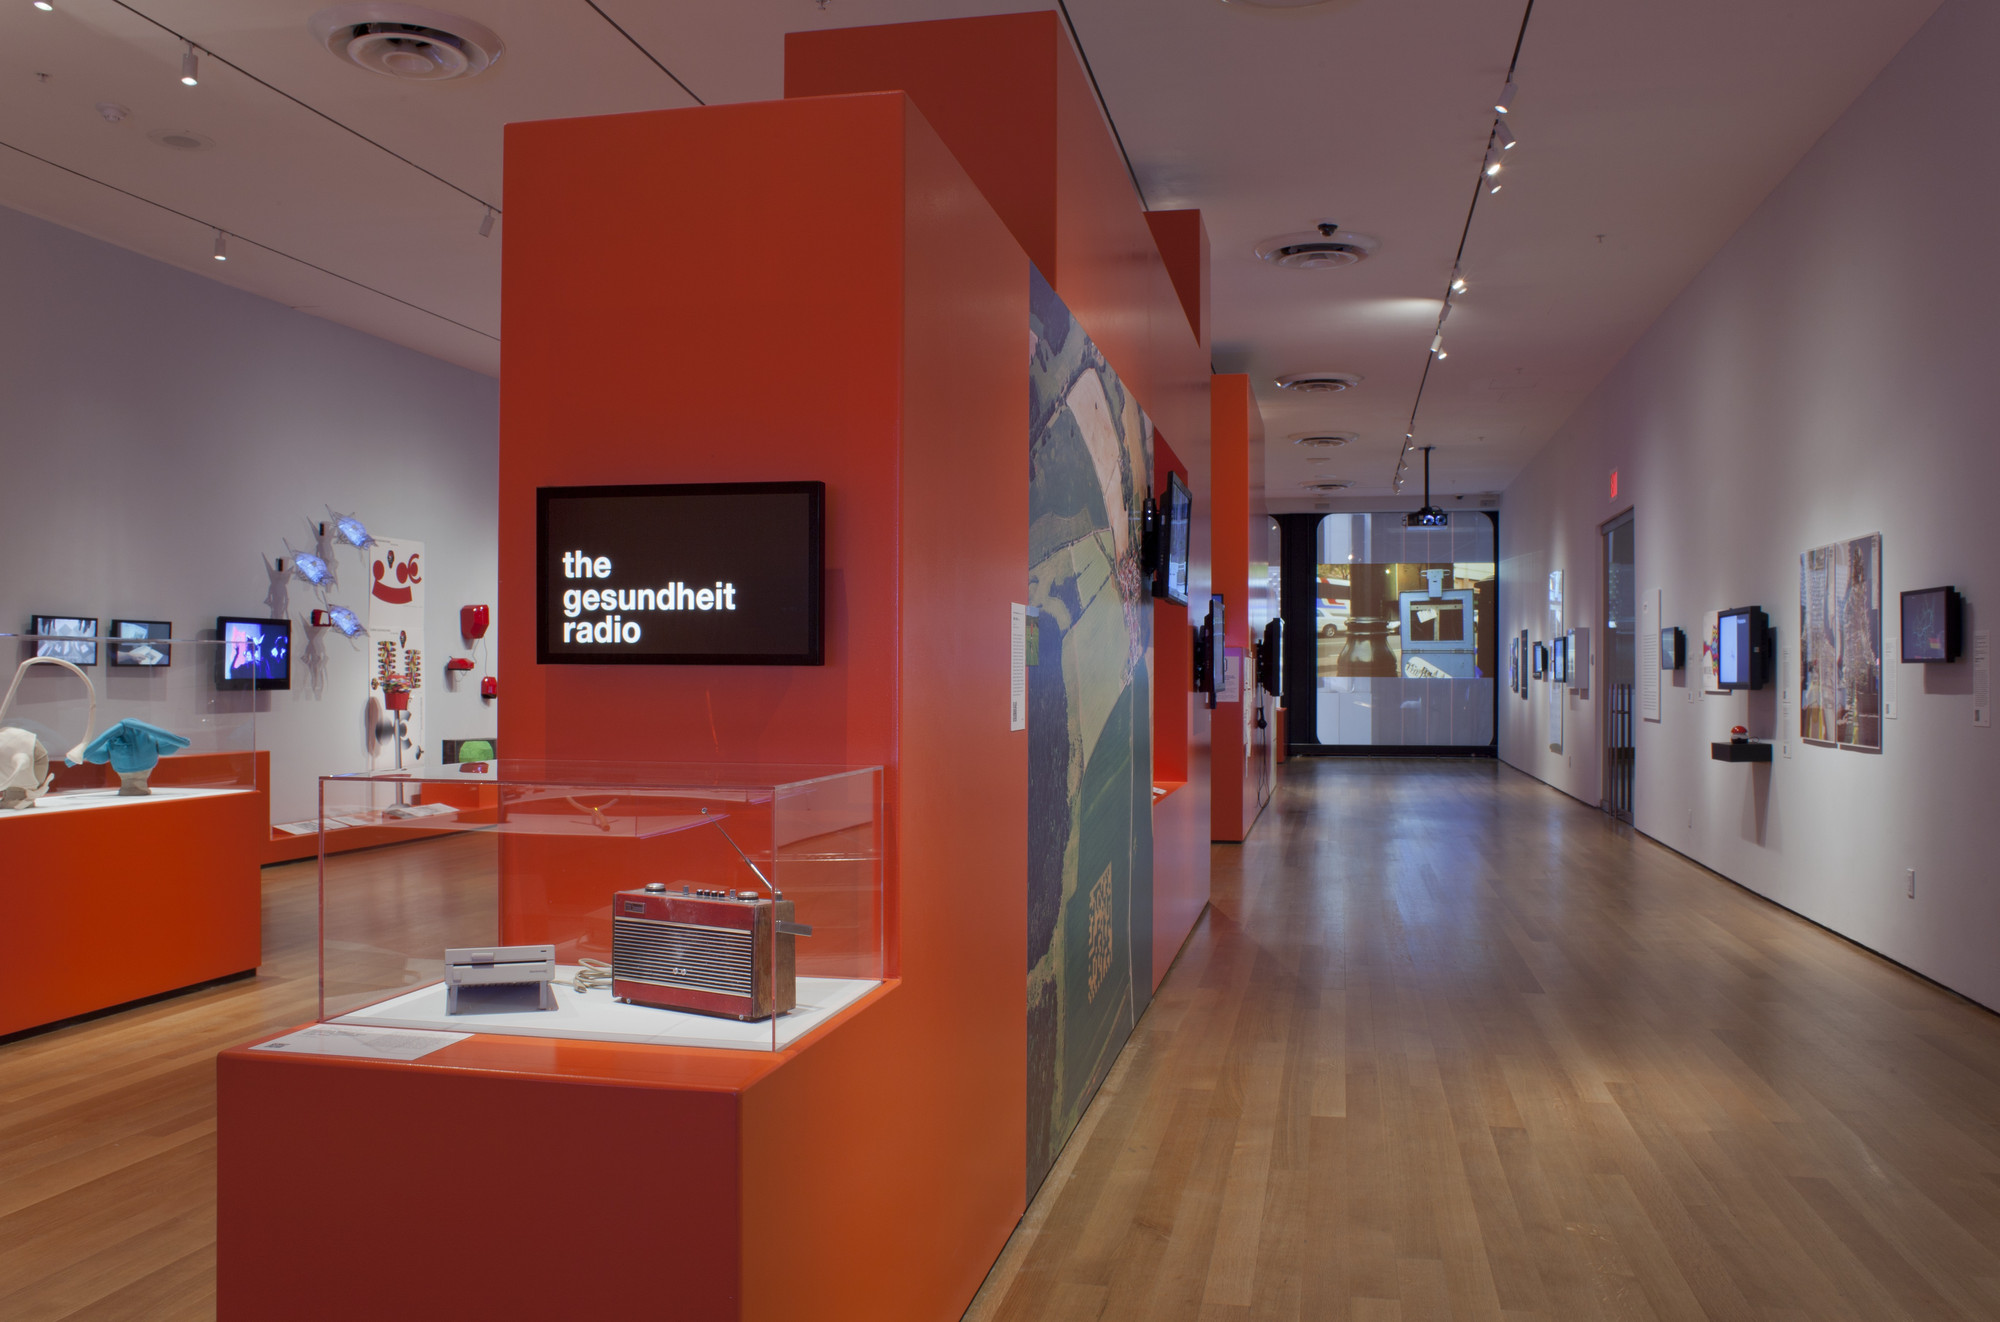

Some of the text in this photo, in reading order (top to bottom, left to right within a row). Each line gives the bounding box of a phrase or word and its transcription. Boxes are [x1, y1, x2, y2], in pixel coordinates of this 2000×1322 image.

[562, 550, 612, 579] the
[563, 581, 736, 618] gesundheit
[563, 615, 642, 644] radio
